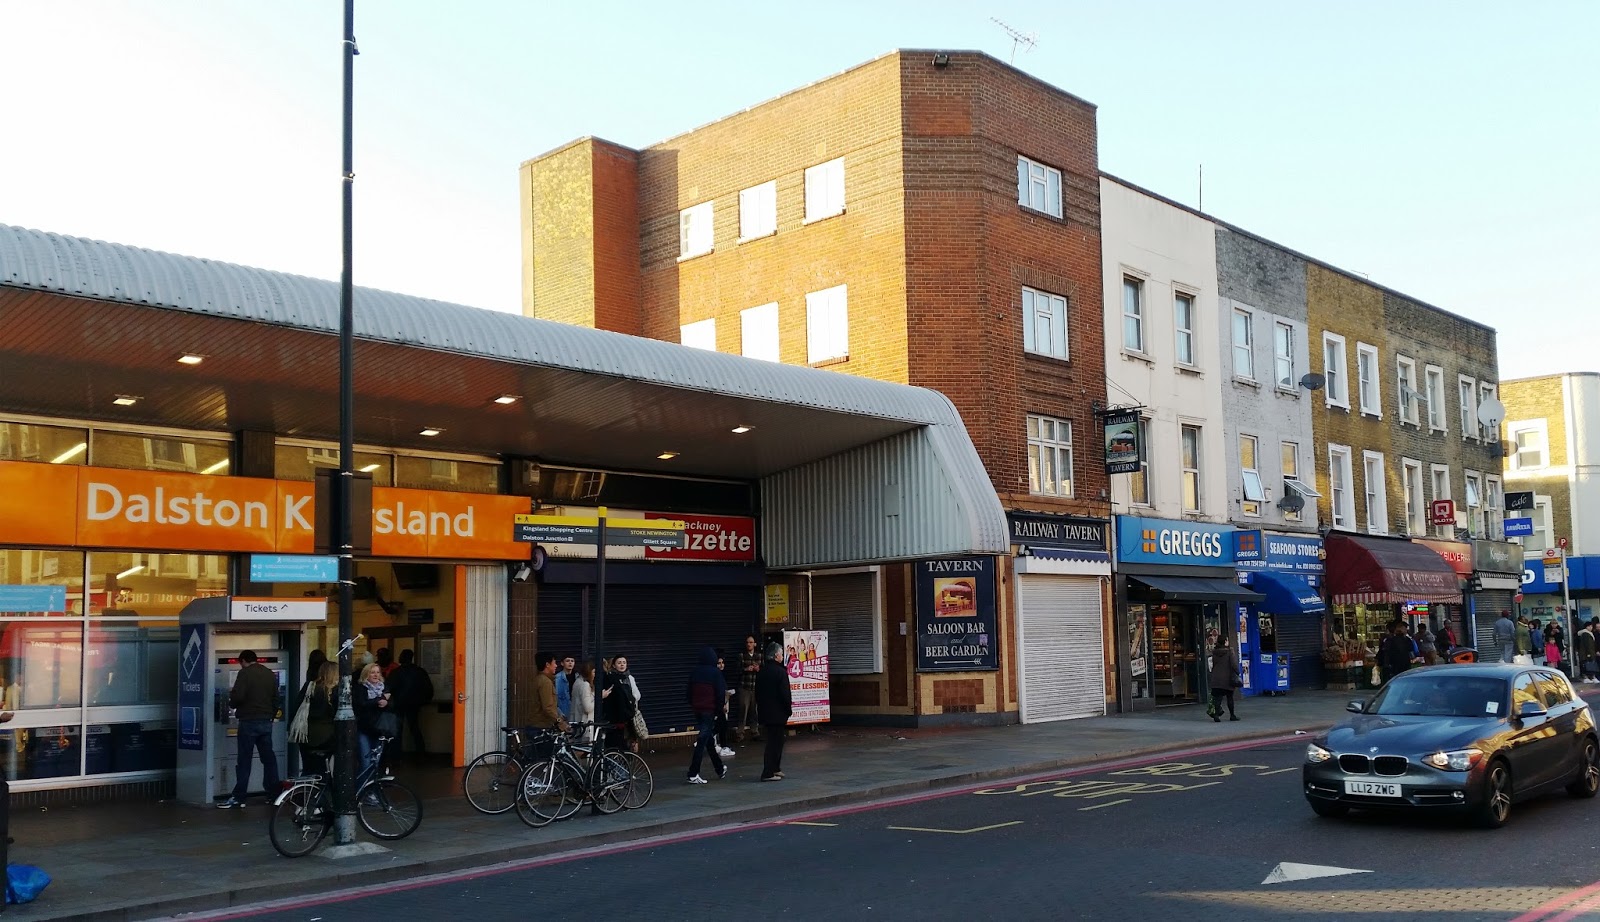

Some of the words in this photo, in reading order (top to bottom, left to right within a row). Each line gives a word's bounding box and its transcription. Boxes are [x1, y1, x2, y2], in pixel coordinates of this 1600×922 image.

[1107, 415, 1135, 425] RAILWAY
[1110, 463, 1135, 472] TAVERN
[87, 482, 268, 527] Dalston
[284, 494, 475, 537] Ksland
[684, 521, 721, 533] ackney
[1014, 521, 1059, 538] RAILWAY
[1063, 524, 1101, 541] TAVERN
[1506, 523, 1531, 531] LAVAZZA
[1159, 529, 1222, 558] GREGGS
[1269, 542, 1297, 555] SEAFOOD
[1297, 544, 1319, 557] STORES
[925, 560, 984, 572] TAVERN
[244, 604, 278, 613] Tickets
[927, 623, 964, 634] SALOON
[966, 622, 985, 633] BAR
[950, 634, 967, 644] and
[925, 646, 949, 658] BEER
[951, 645, 989, 657] GARDEN
[803, 664, 828, 672] ENGLISH
[803, 672, 828, 681] SCIENCE
[182, 682, 201, 692] Tickets
[802, 681, 828, 690] LESSONS
[1107, 762, 1270, 778] BUS
[972, 780, 1187, 799] STOP
[1350, 783, 1373, 794] LL12
[1374, 784, 1395, 795] ZWG
